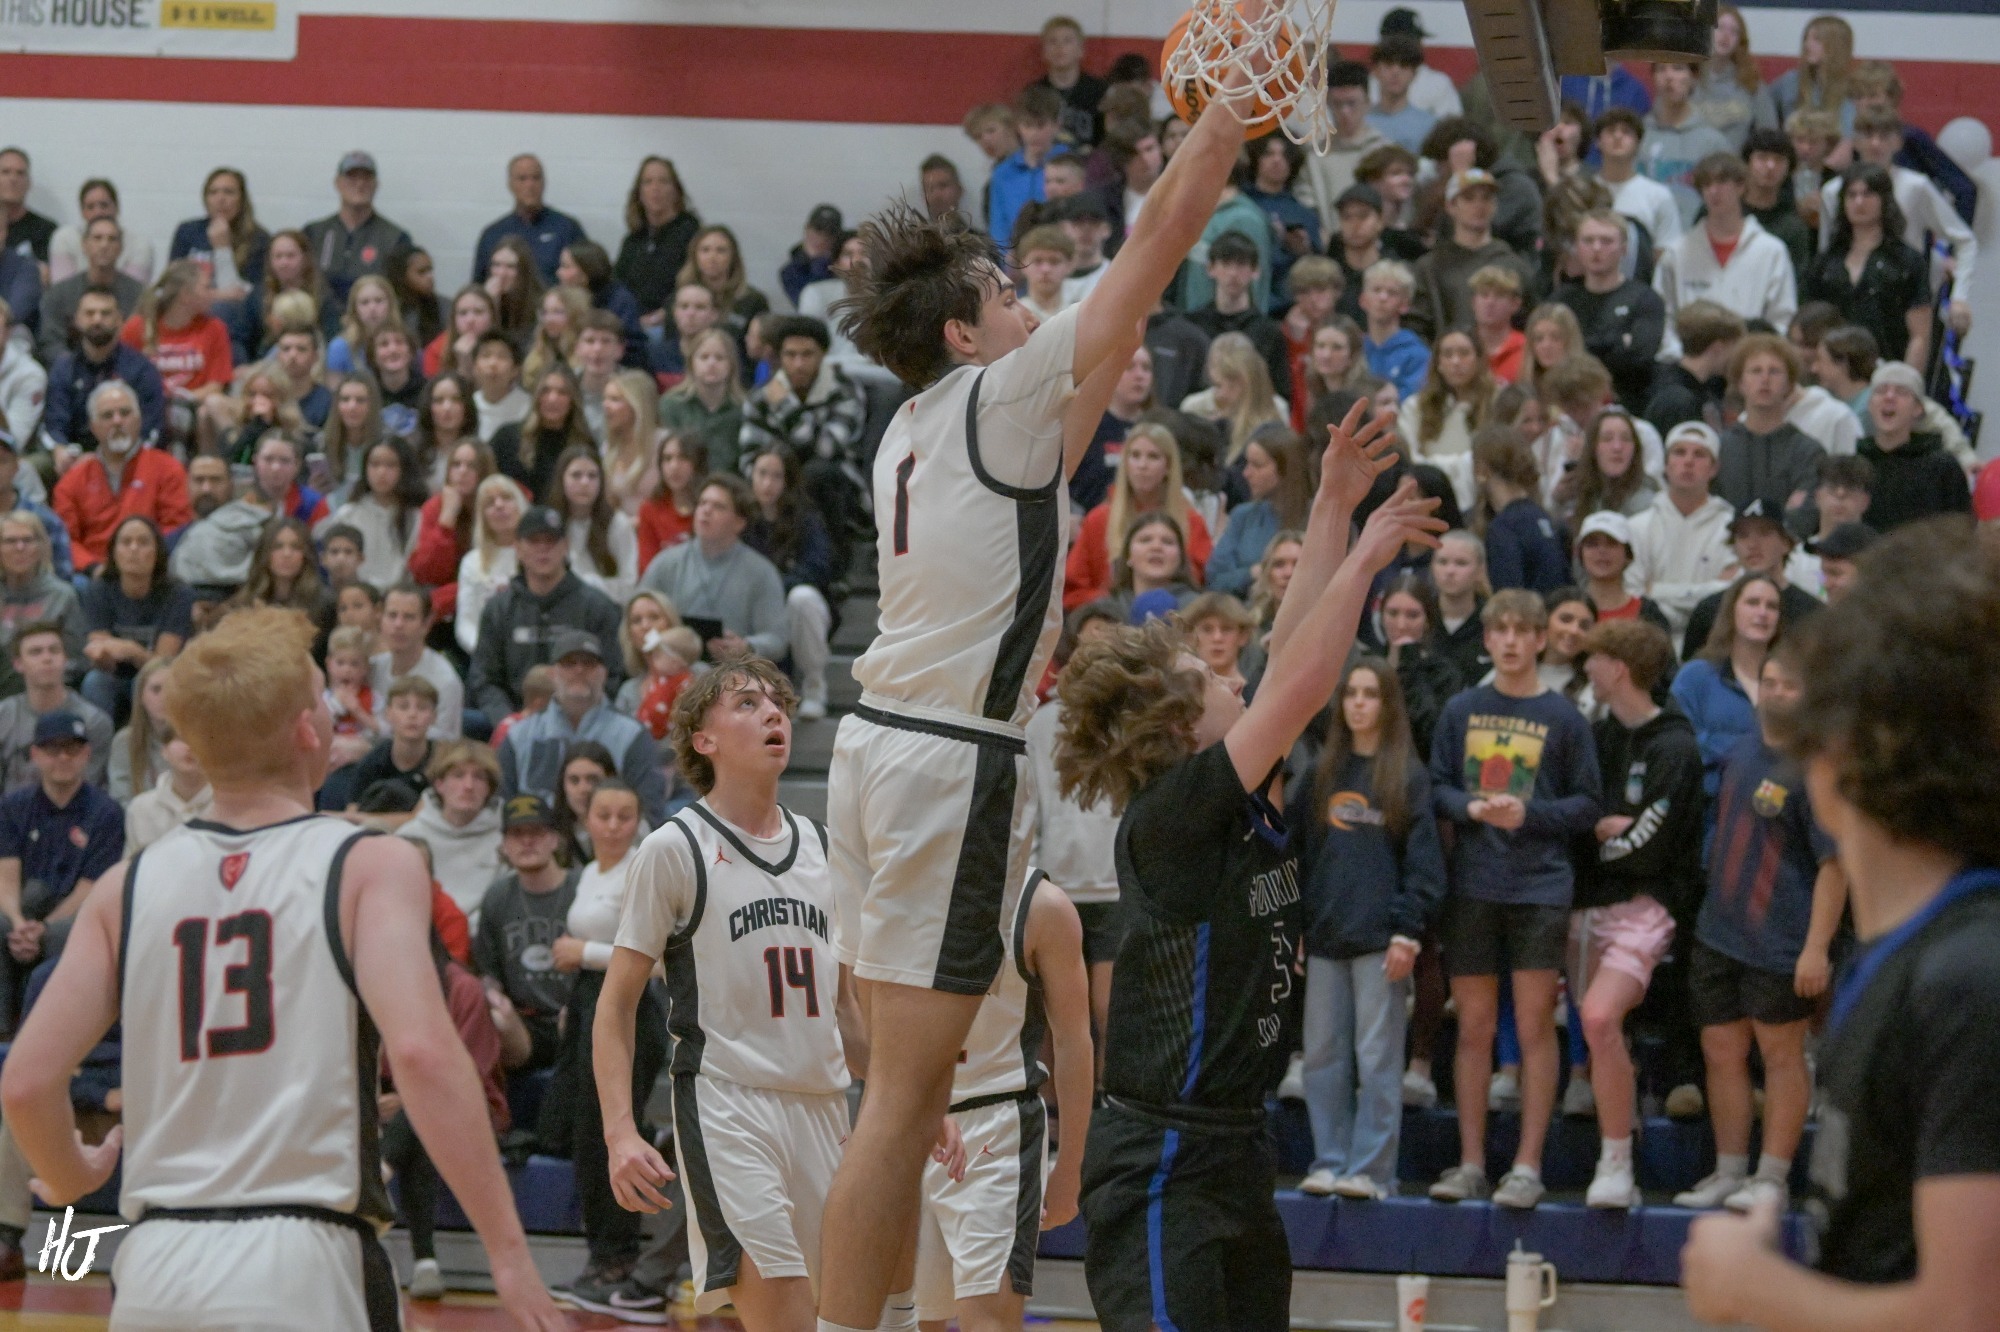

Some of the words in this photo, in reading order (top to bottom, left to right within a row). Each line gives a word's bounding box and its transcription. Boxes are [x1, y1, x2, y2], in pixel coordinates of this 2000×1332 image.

[894, 451, 916, 556] 1
[1468, 713, 1549, 739] MICHIGAN
[729, 897, 829, 944] CHRISTIAN
[172, 909, 275, 1063] 13
[764, 946, 820, 1018] 14
